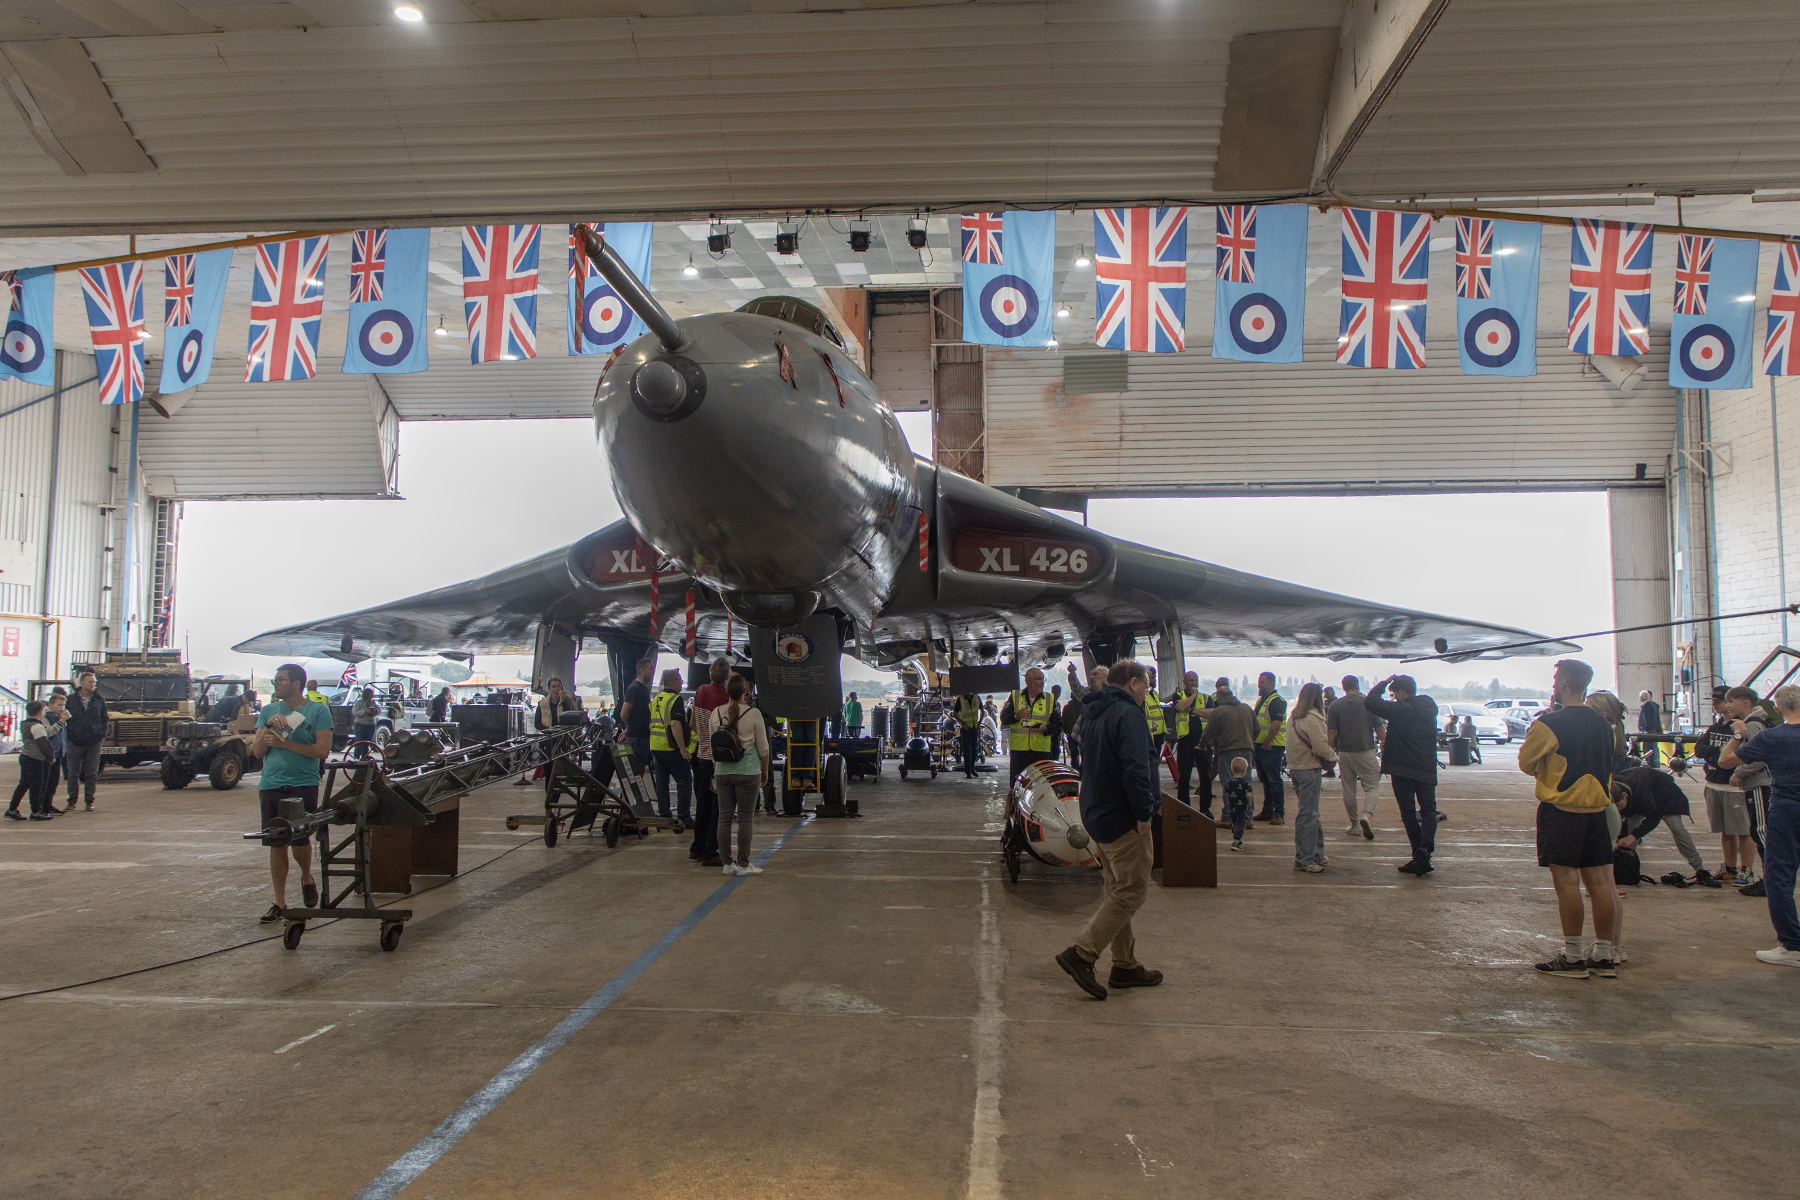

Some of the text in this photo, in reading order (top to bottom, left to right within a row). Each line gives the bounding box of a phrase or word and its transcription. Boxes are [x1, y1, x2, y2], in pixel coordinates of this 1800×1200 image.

[610, 549, 646, 573] XL
[979, 547, 1088, 573] XL 426
